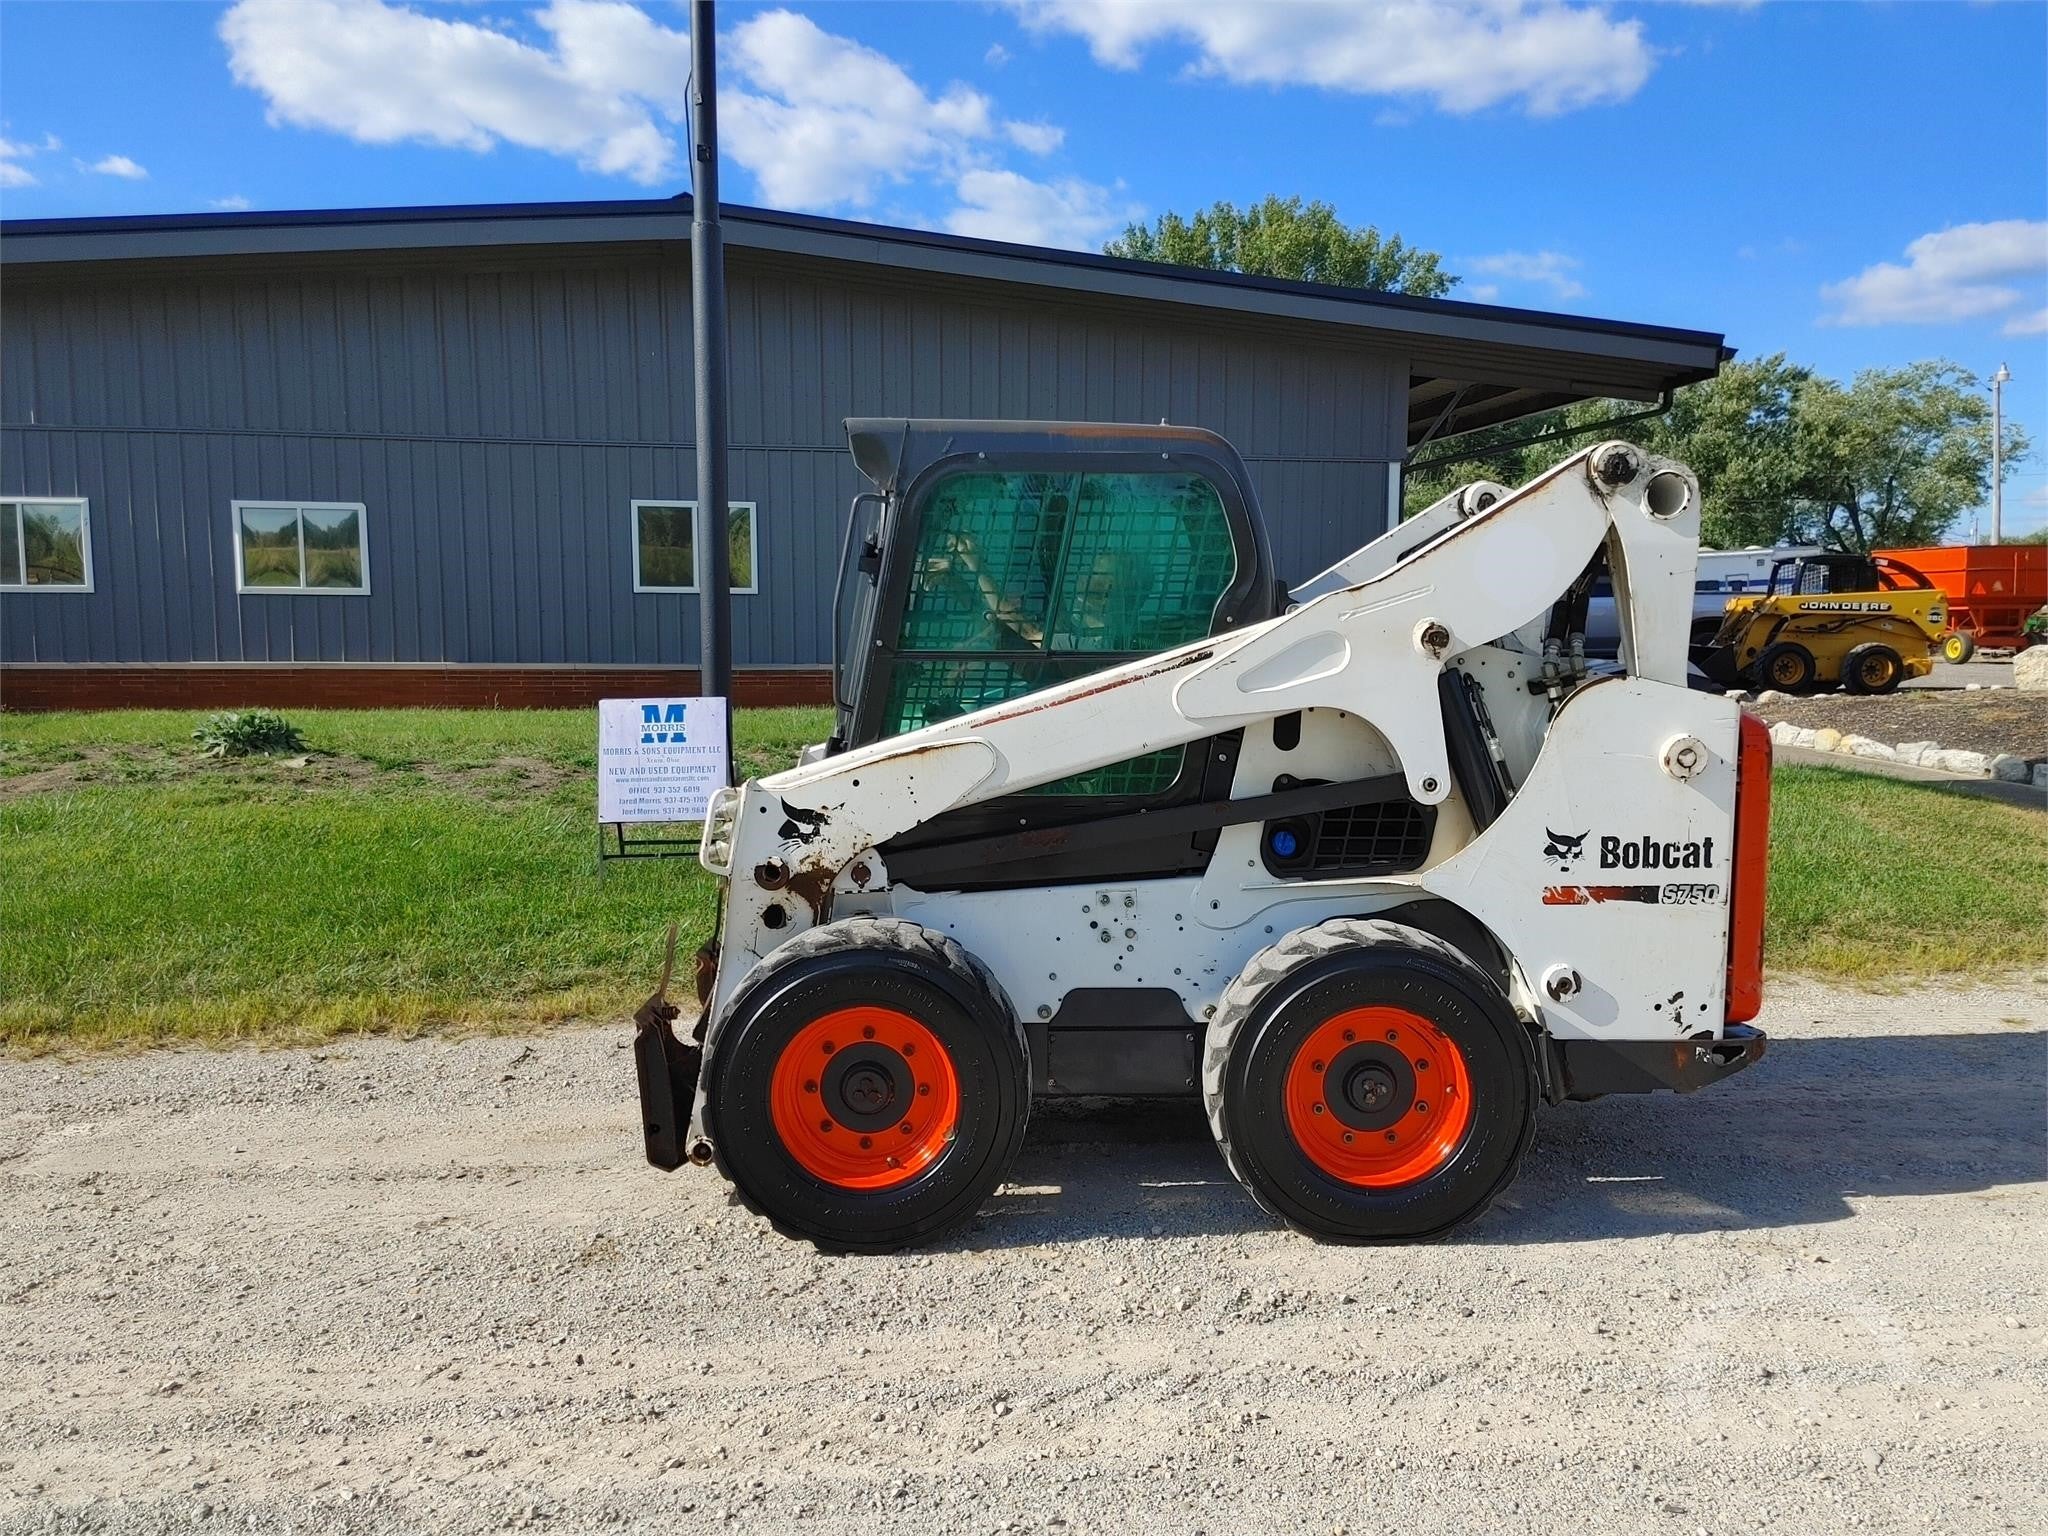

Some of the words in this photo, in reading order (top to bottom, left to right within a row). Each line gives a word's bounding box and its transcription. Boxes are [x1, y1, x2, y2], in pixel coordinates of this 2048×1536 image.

[1800, 601, 1839, 610] JOHN
[1842, 602, 1891, 611] DEERE
[641, 724, 686, 732] MORRIS
[603, 747, 632, 756] MORRIS
[634, 747, 639, 756] &
[641, 747, 661, 755] SONS
[663, 746, 706, 755] EQUIPMENT
[708, 746, 721, 754] LLC
[608, 767, 627, 776] NEW
[629, 767, 646, 775] AND
[648, 766, 669, 775] USED
[671, 765, 717, 774] EQUIPMENT
[628, 786, 650, 794] OFFICE
[1600, 835, 1714, 869] Bobcat
[1661, 883, 1721, 905] S750
